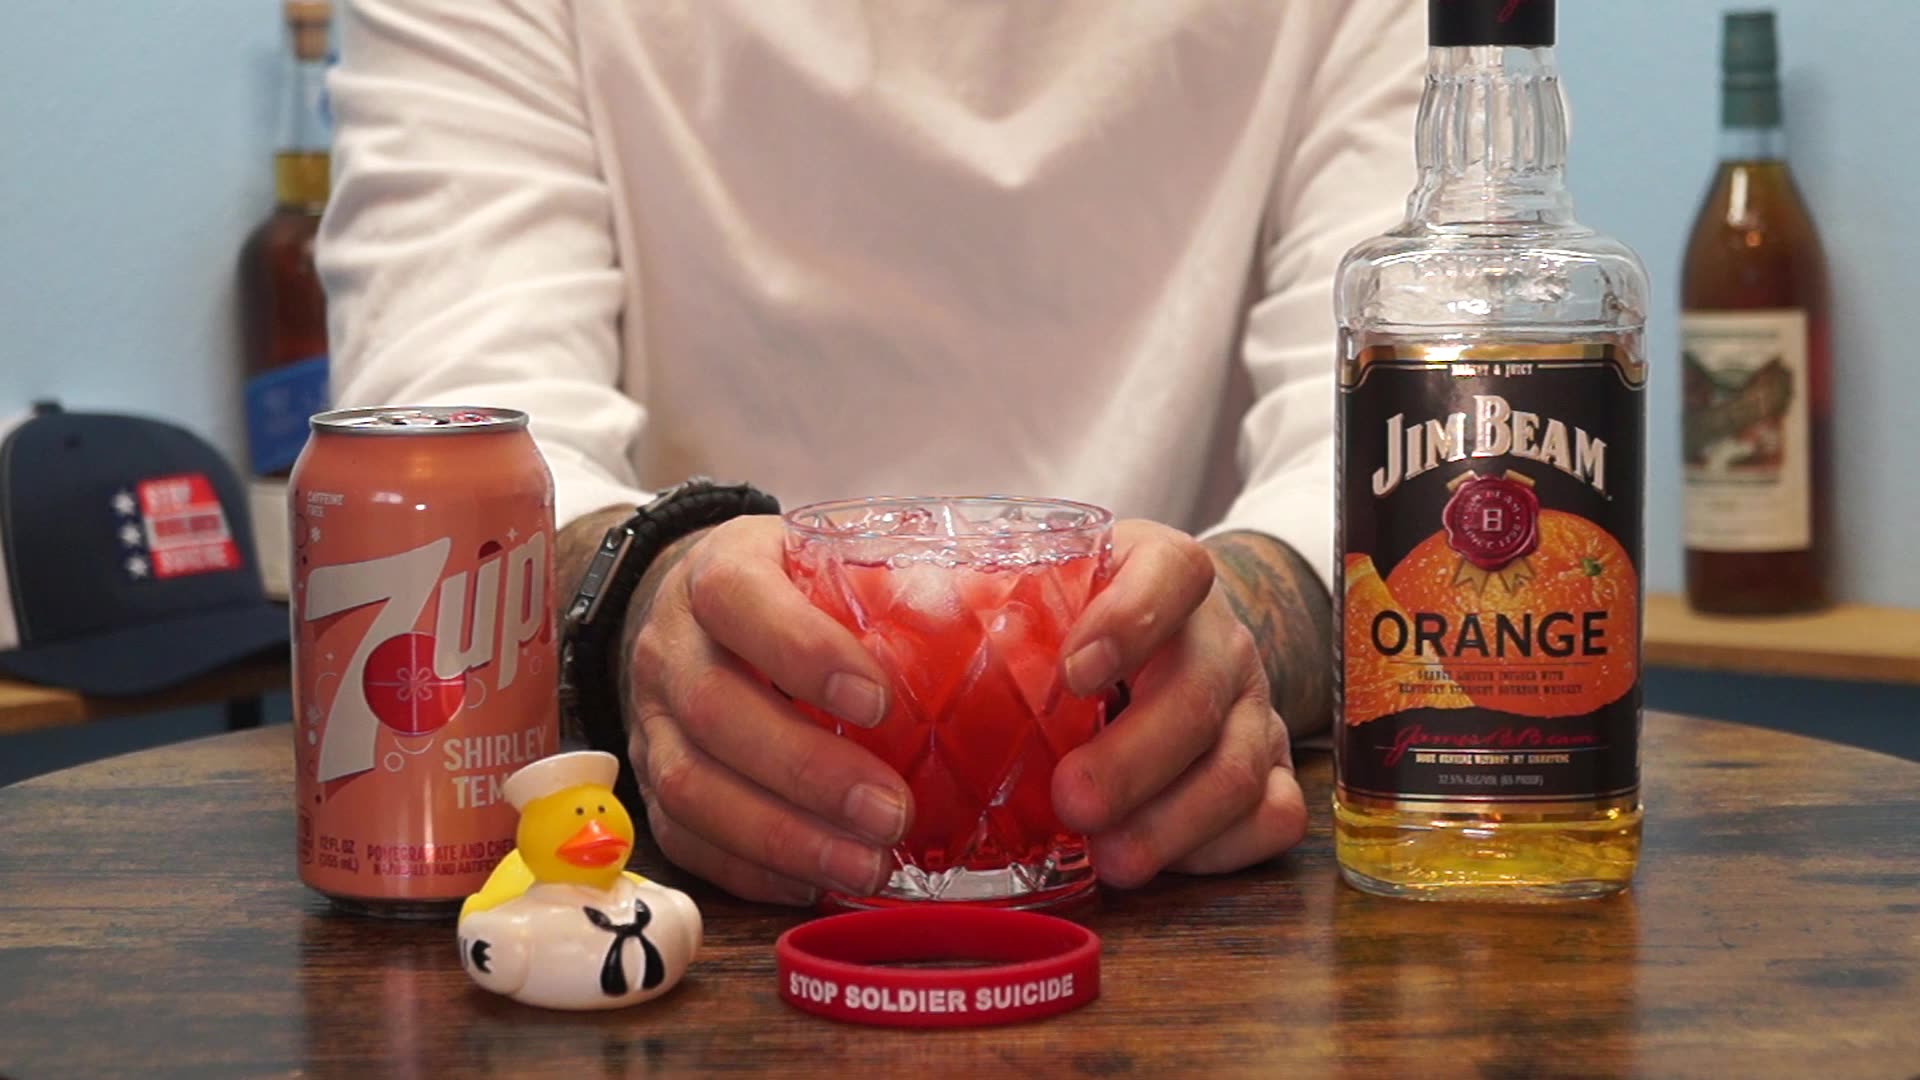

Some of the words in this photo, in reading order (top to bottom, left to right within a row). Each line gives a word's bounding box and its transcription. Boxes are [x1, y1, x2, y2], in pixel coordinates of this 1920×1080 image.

[1372, 412, 1467, 496] JIM
[1471, 394, 1608, 492] BEAM
[1371, 610, 1608, 657] ORANGE
[443, 726, 547, 772] SHIRLEY
[451, 772, 511, 809] TEM
[789, 972, 838, 1004] STOP
[844, 983, 968, 1013] SOLDIER
[974, 973, 1074, 1011] SUICIDE
